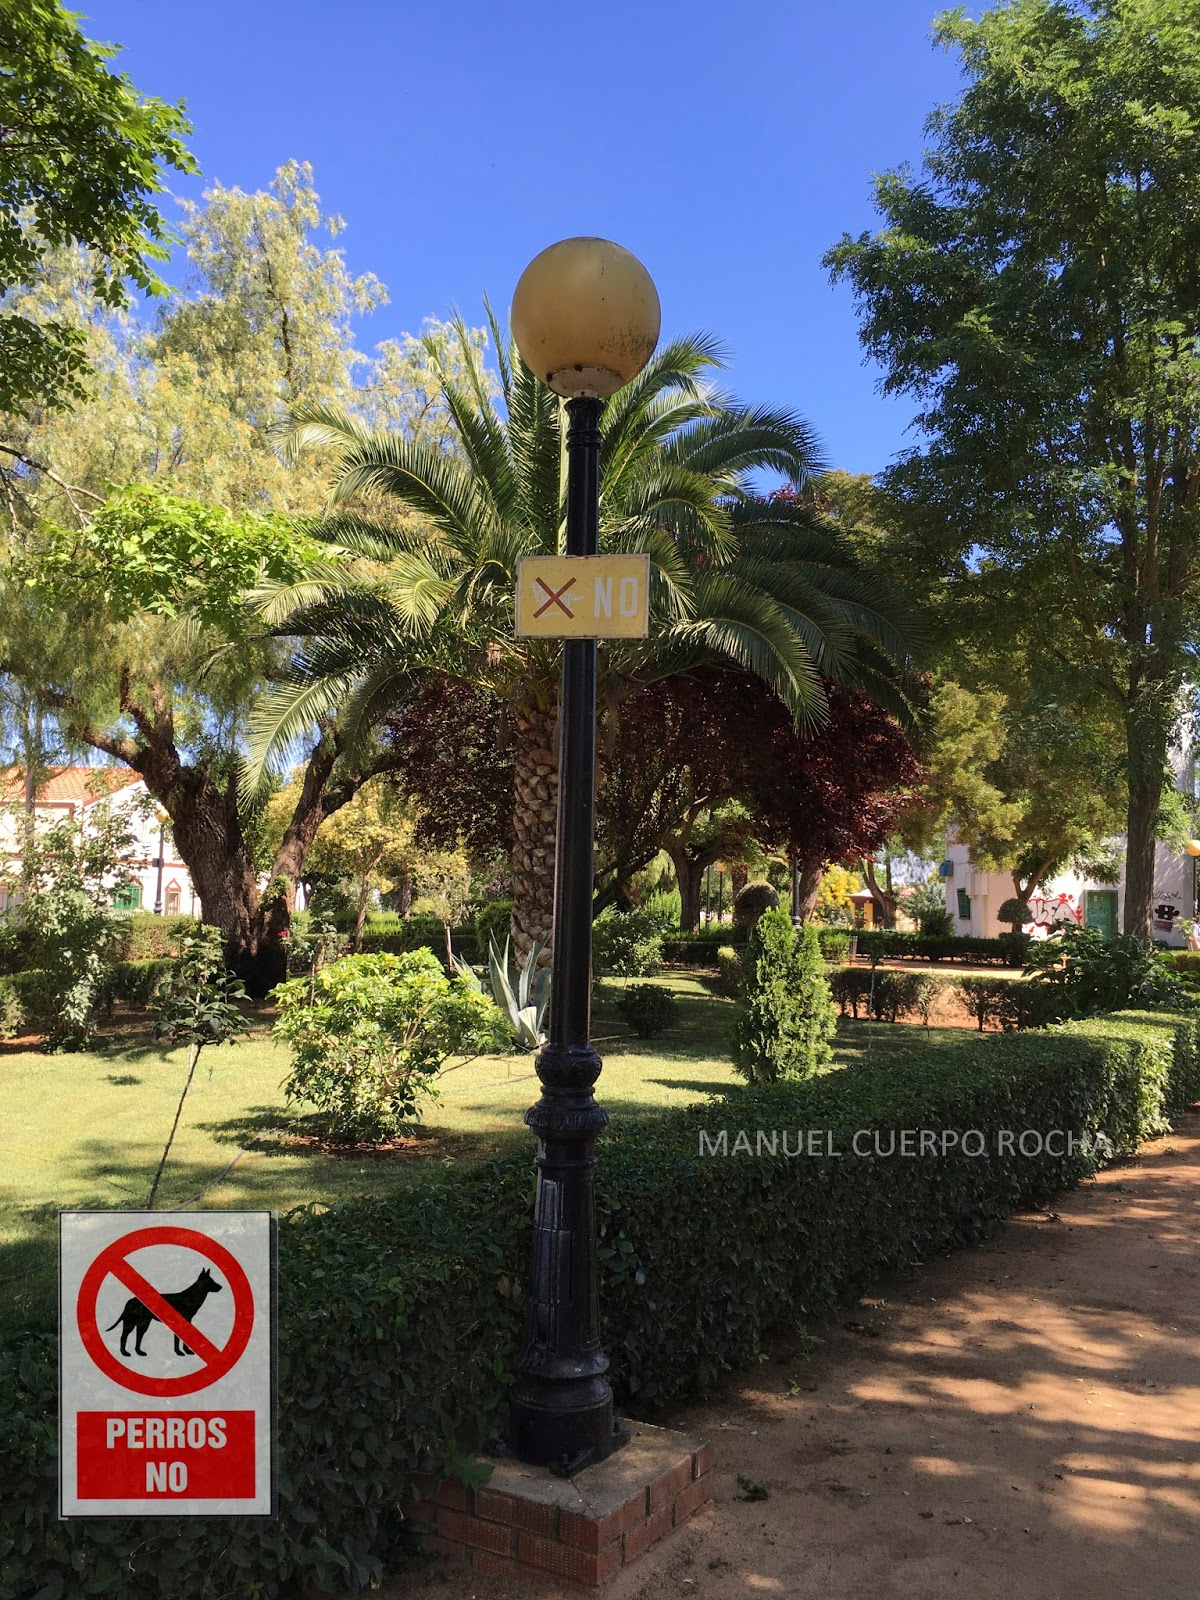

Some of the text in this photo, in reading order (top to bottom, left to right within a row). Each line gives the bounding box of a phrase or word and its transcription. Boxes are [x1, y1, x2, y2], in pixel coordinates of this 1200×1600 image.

[594, 576, 638, 618] NO
[106, 1417, 228, 1449] PERROS
[146, 1461, 188, 1493] NO
